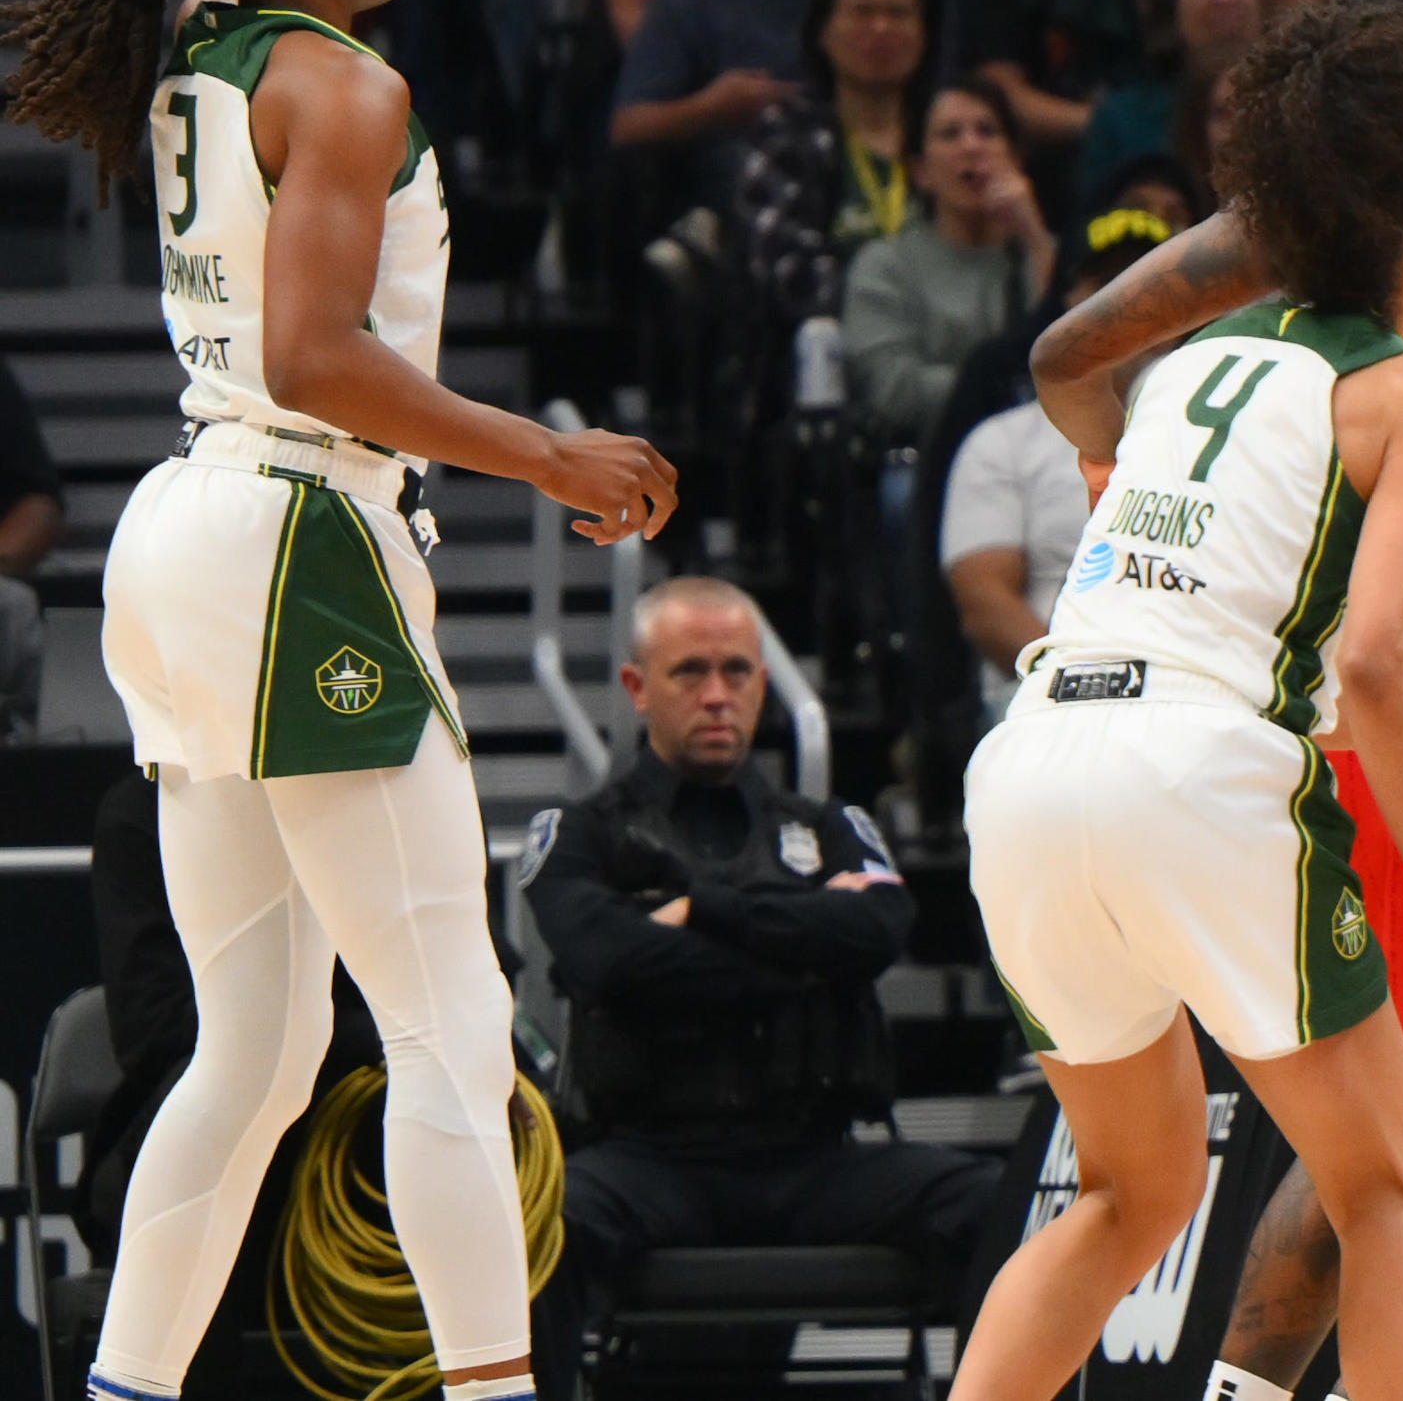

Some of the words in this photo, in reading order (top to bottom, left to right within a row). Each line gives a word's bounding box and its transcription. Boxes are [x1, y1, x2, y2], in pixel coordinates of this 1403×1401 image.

[167, 92, 198, 237] 3
[1185, 353, 1280, 483] 4
[1106, 488, 1215, 549] DIGGINS
[1115, 551, 1208, 595] AT&T
